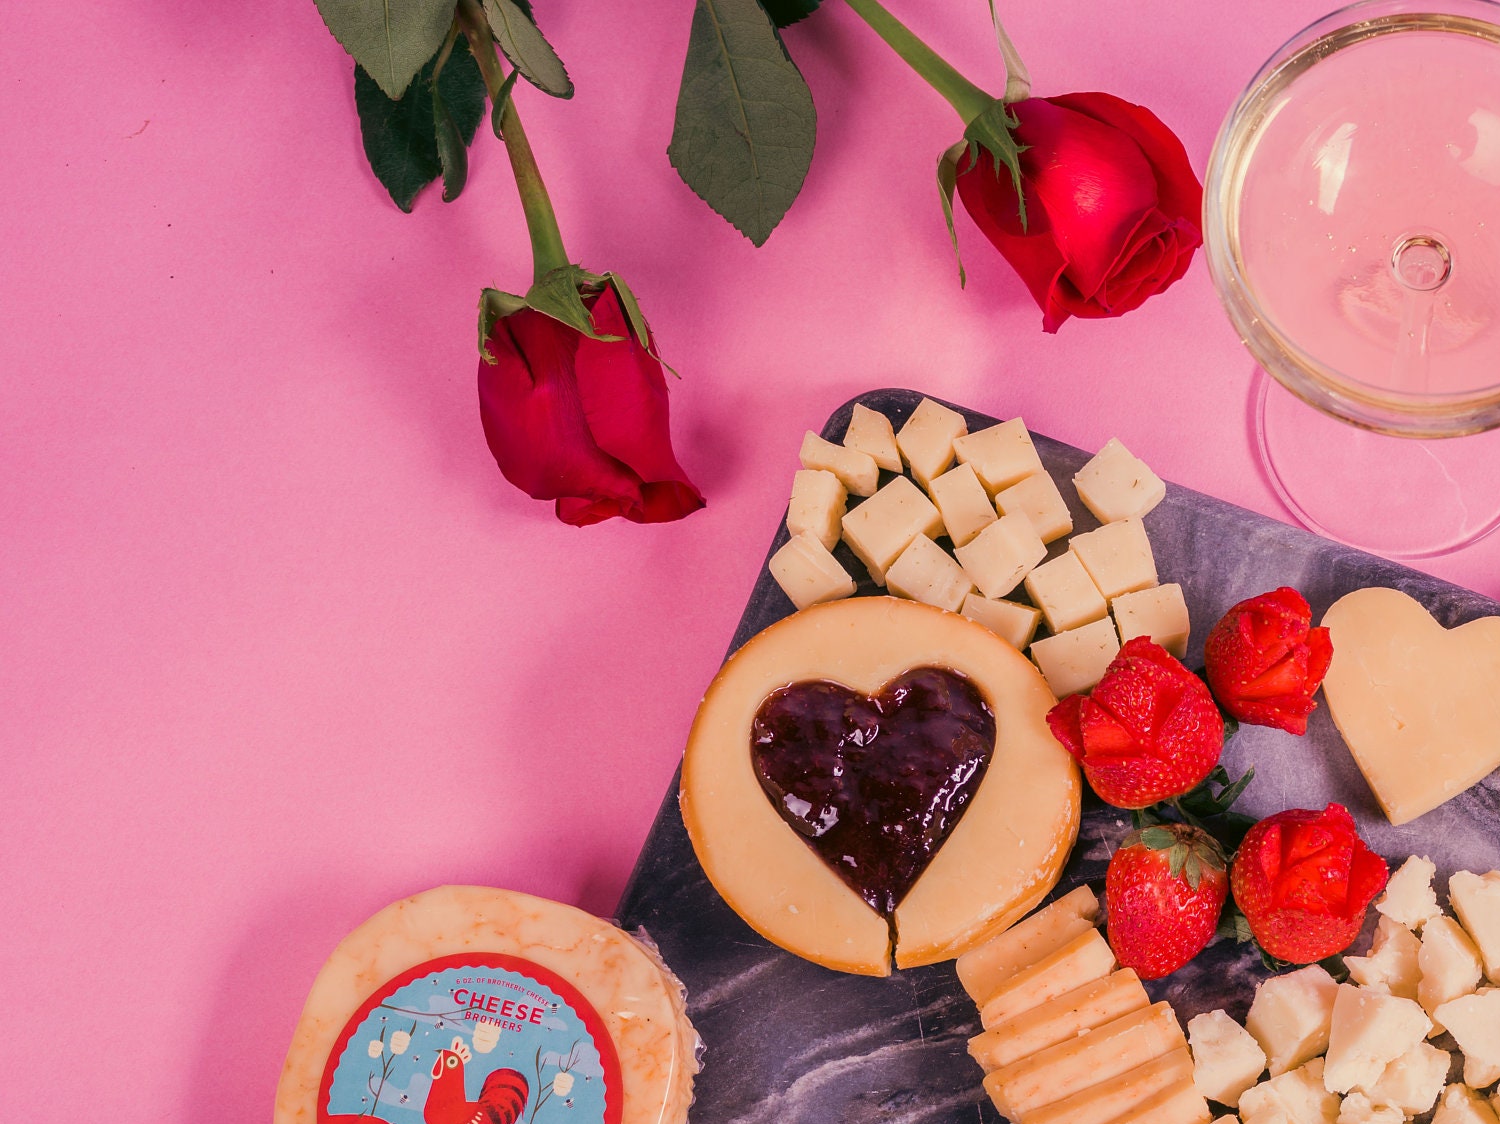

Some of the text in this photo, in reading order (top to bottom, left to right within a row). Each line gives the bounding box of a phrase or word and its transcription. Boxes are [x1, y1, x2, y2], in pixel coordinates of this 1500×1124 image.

[454, 988, 544, 1025] CHEESE
[487, 978, 525, 993] BROTHERLY
[526, 990, 549, 1007] CHEESE
[465, 1011, 522, 1032] BROTHERS
